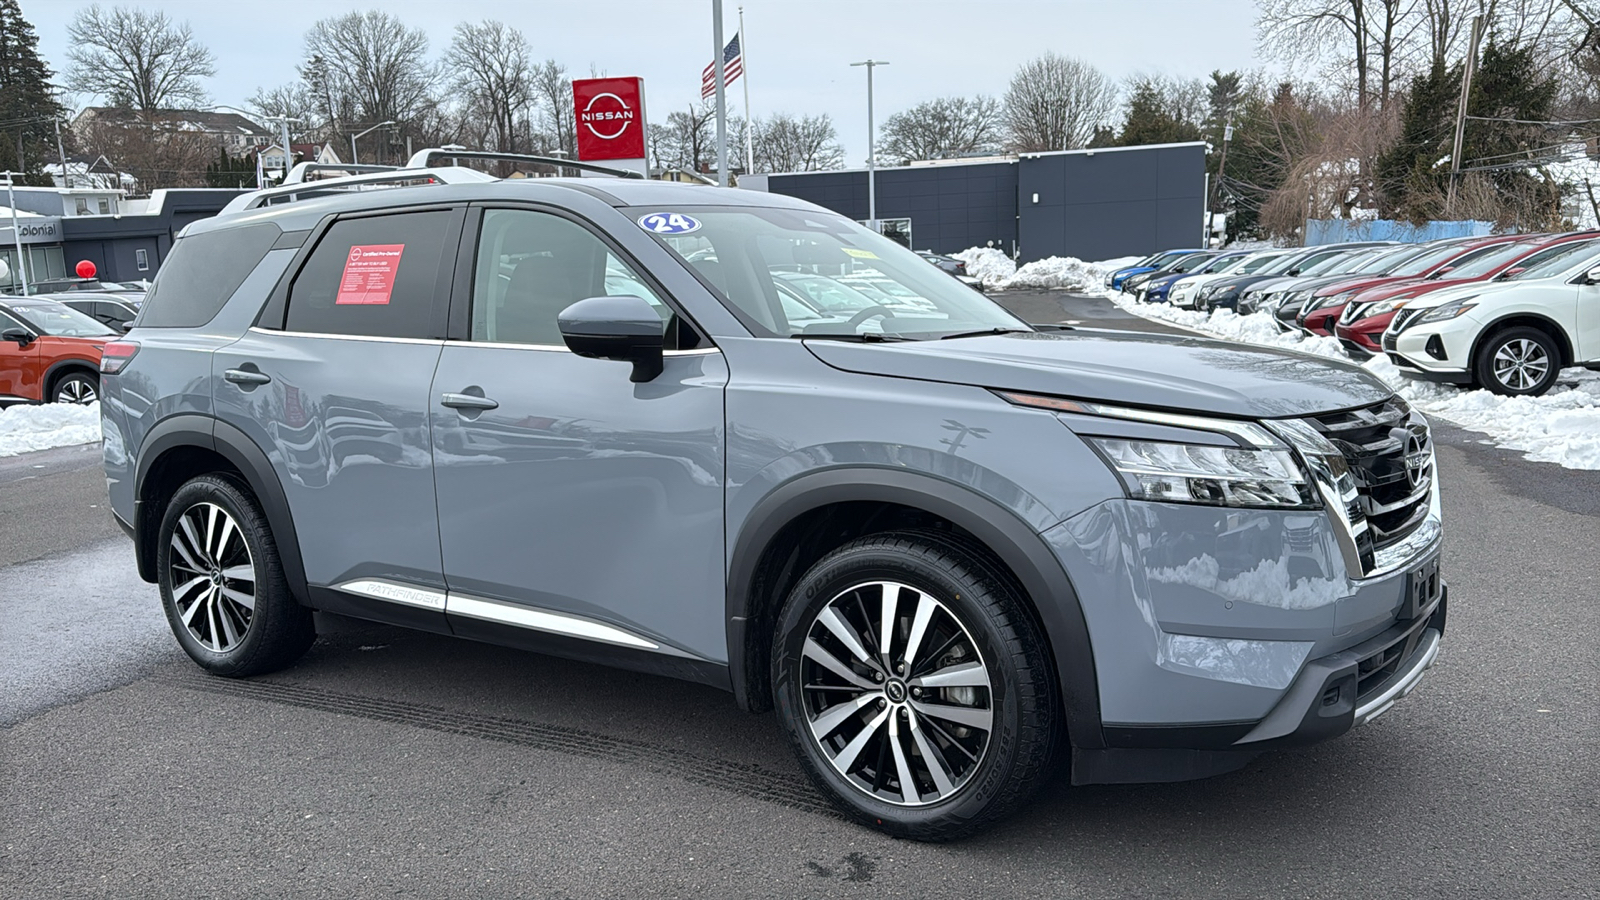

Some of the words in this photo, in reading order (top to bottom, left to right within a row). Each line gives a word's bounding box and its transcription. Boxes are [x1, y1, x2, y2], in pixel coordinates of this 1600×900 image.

[581, 110, 634, 121] NISSAN
[647, 214, 690, 232] 24
[366, 583, 441, 605] PATHFINDER
